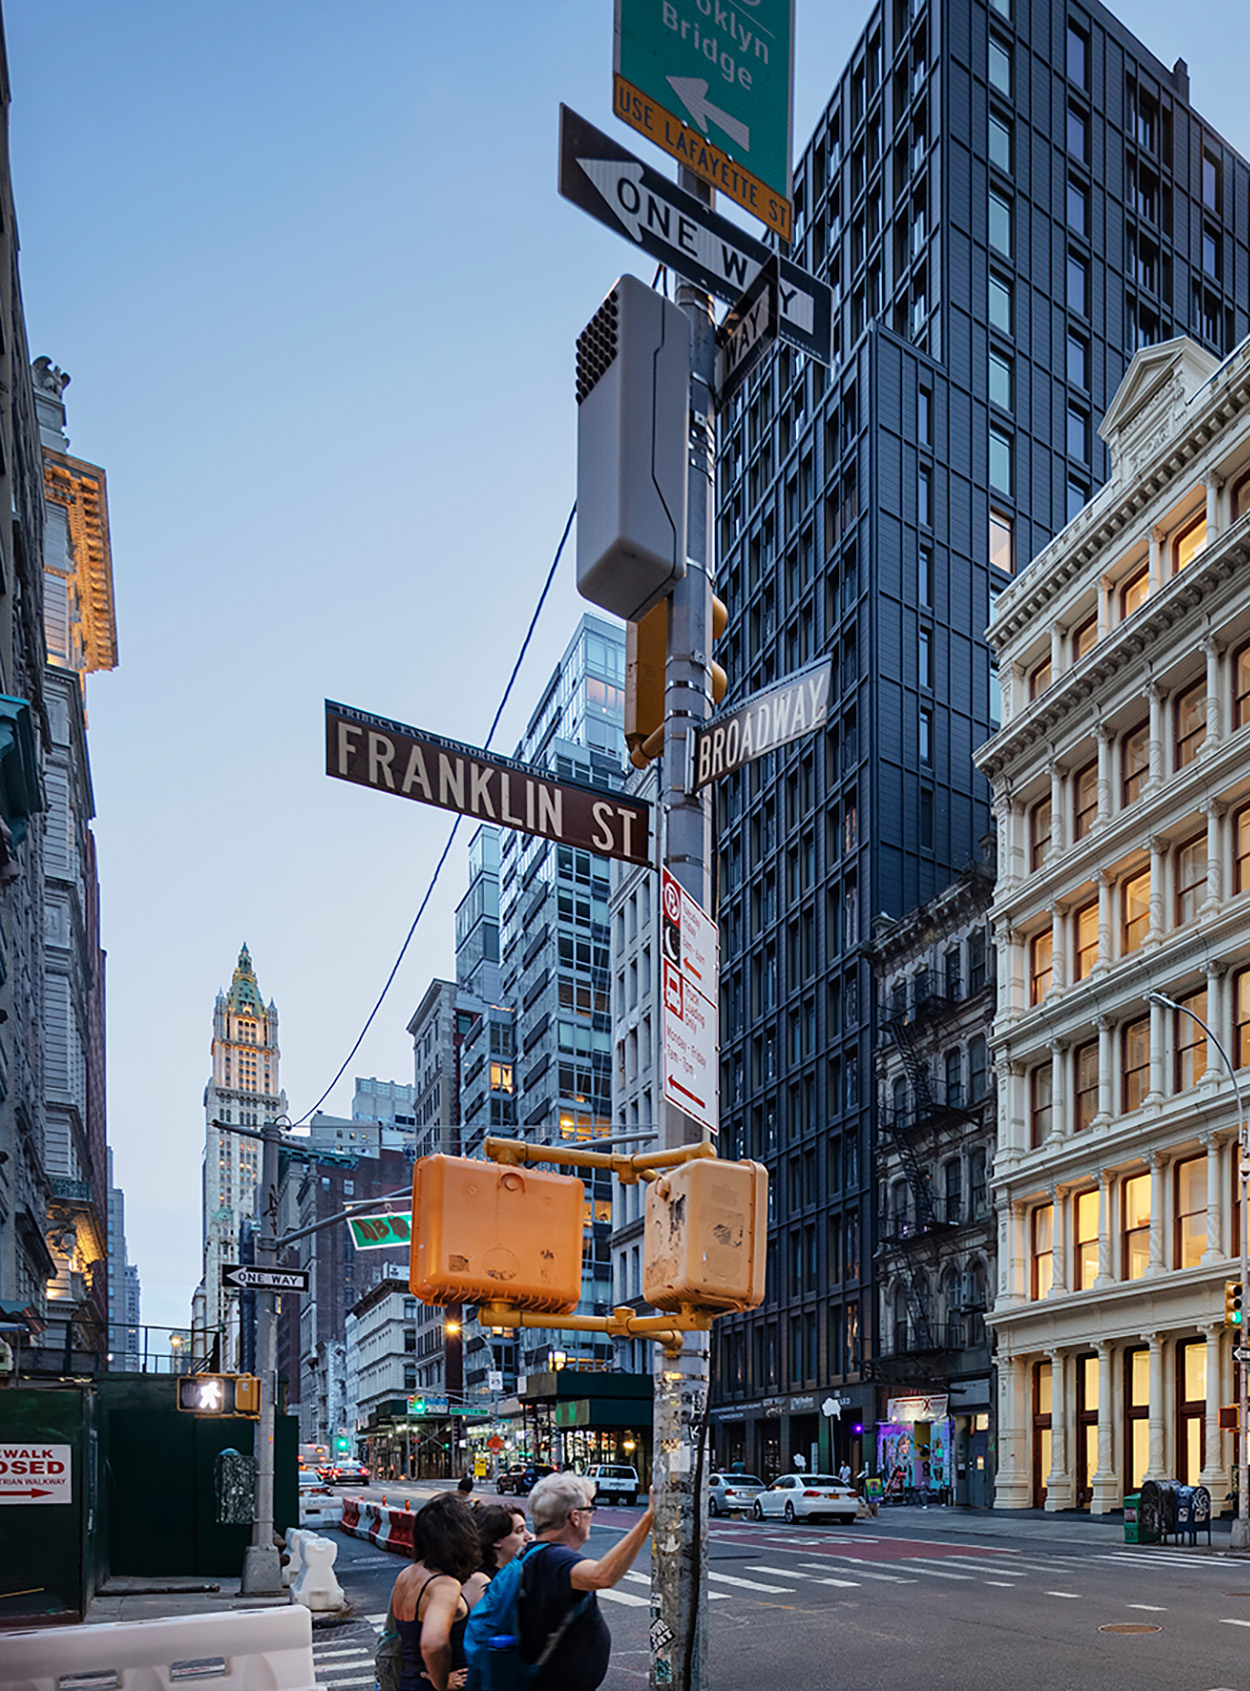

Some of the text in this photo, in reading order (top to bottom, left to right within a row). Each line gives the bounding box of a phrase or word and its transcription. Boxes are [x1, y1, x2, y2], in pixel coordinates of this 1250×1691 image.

[662, 1, 752, 91] Bridge
[620, 87, 787, 228] USE LAFAYETTE ST
[617, 177, 699, 258] ONE
[339, 704, 559, 783] TRIBECA EAST HISTORIC DISTRICT
[698, 673, 825, 784] BROADWAY
[337, 720, 637, 858] FRANKLIN ST
[238, 1272, 297, 1285] ONE WAY
[0, 1449, 54, 1459] WALK
